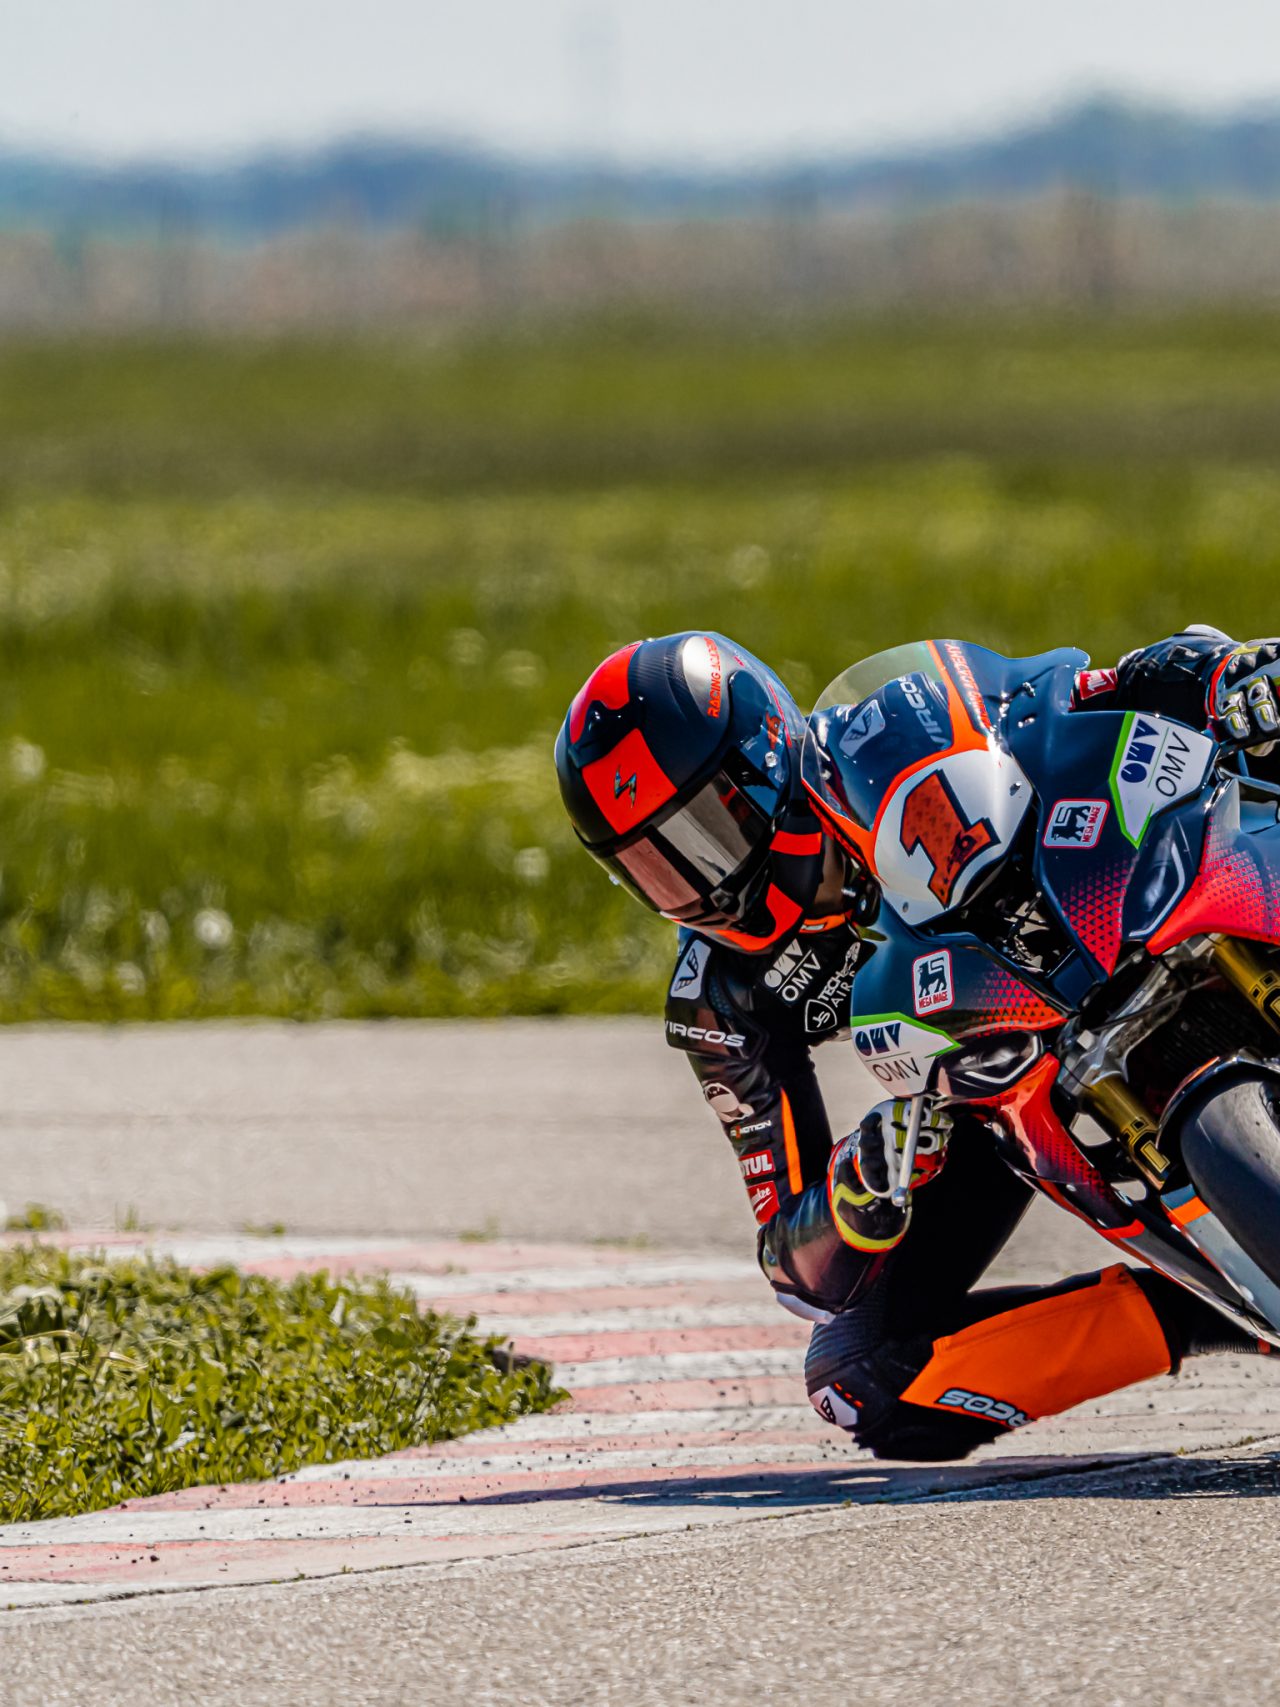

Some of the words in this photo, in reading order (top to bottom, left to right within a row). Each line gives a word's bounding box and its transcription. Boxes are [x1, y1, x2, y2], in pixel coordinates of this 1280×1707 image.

[707, 672, 721, 719] RACING
[1155, 731, 1191, 797] OMV
[899, 769, 1001, 910] 1
[781, 953, 821, 1002] OMV
[817, 970, 843, 1001] TECH
[872, 1056, 921, 1082] OMV
